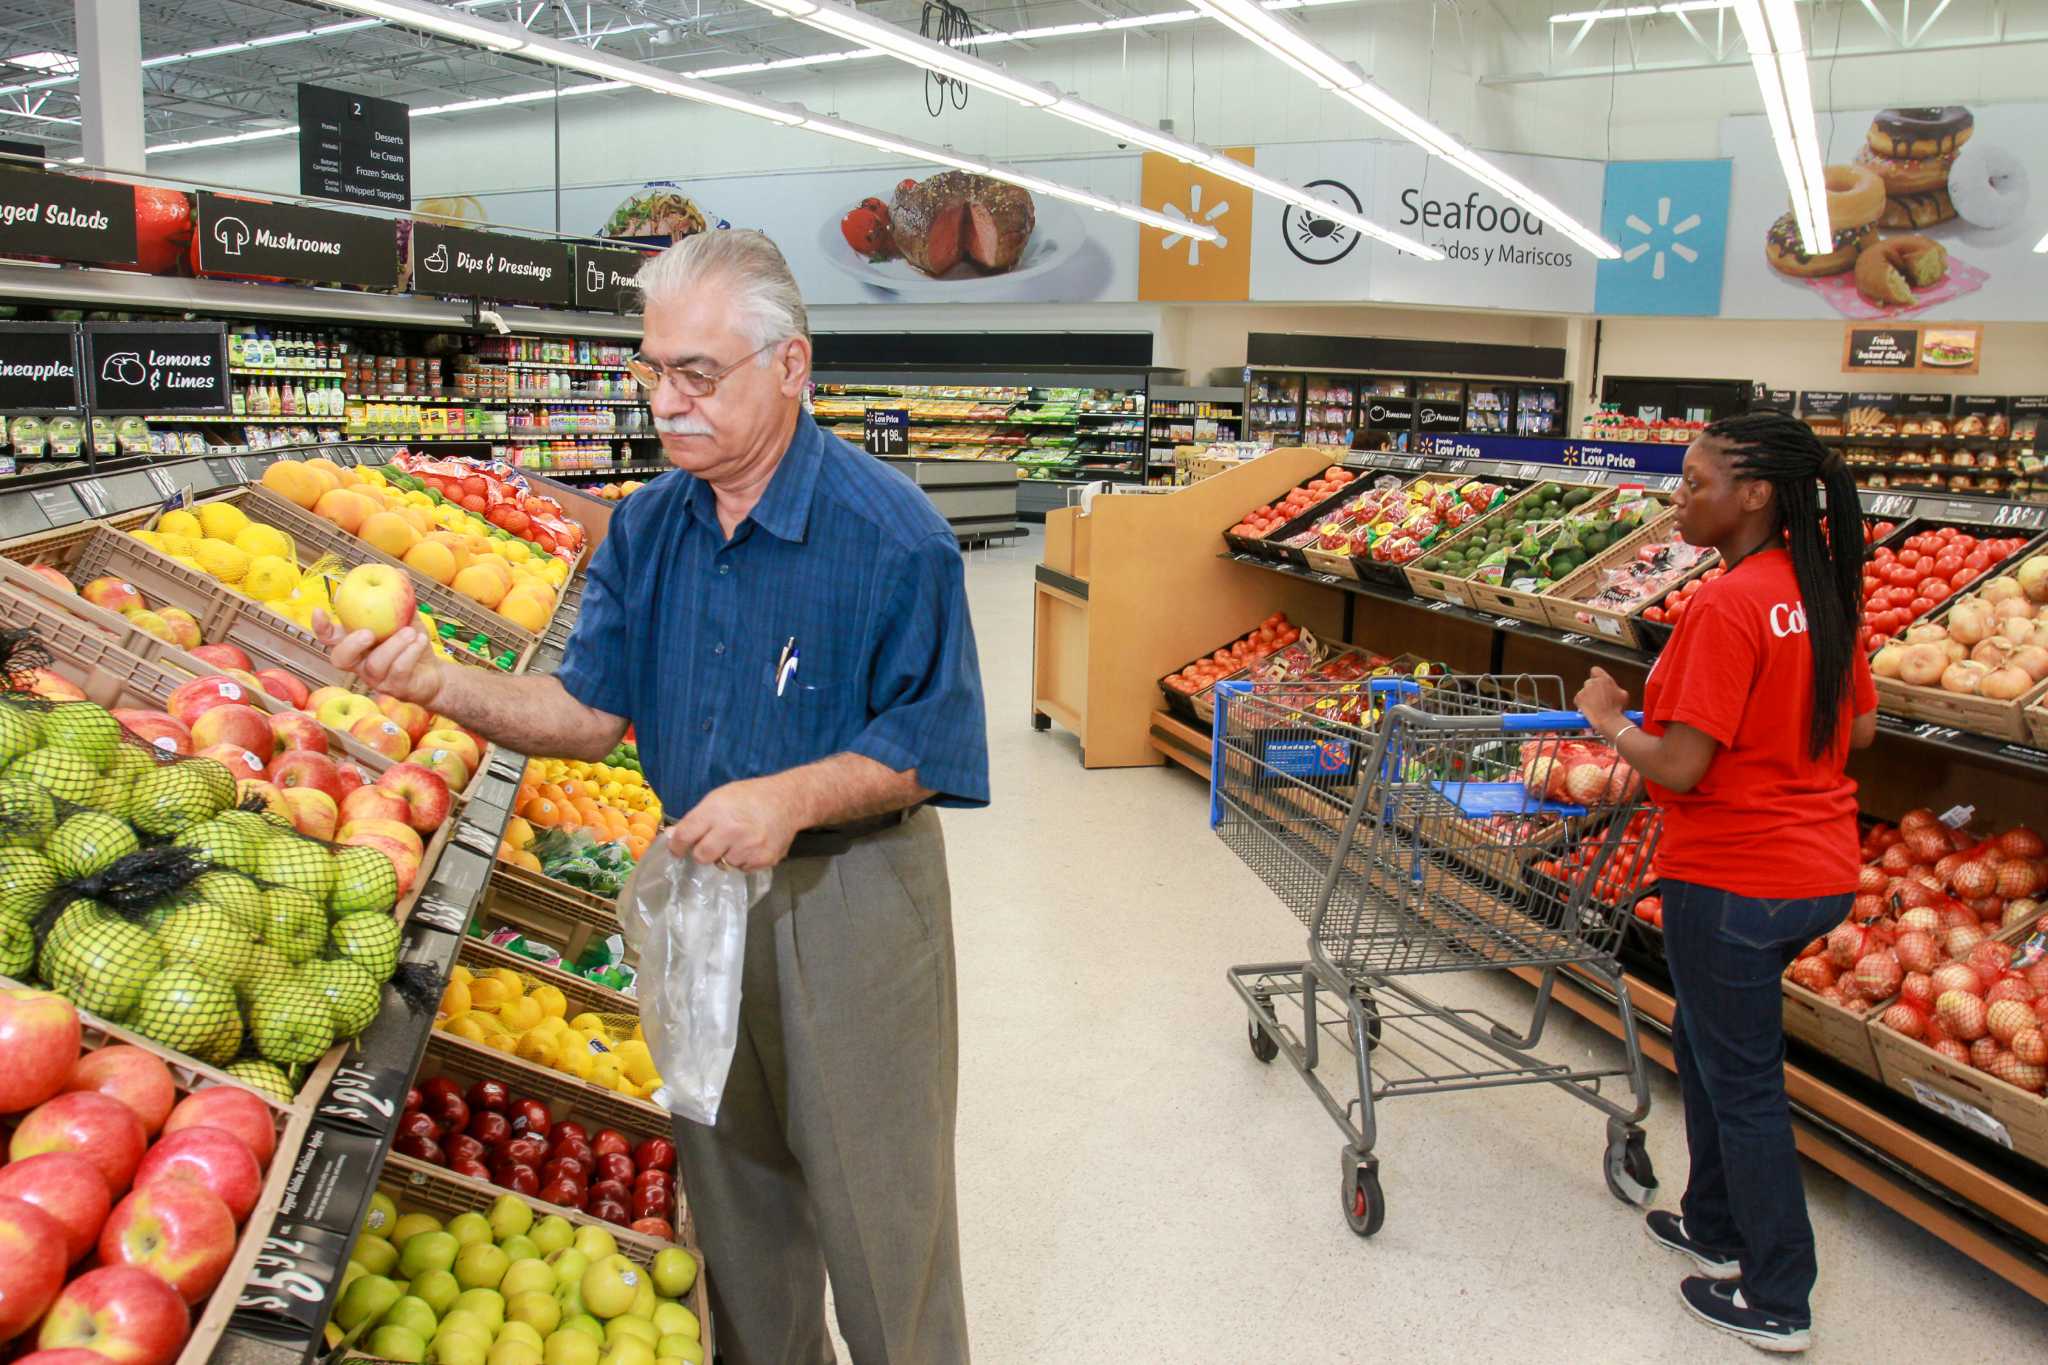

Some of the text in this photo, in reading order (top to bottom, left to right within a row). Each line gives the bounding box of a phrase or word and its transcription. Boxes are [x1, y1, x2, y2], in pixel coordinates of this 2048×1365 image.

[353, 102, 362, 116] 2
[375, 131, 404, 145] Desserts
[370, 149, 404, 163] Ice Cream
[356, 166, 404, 182] Frozen Snacks
[344, 184, 375, 197] Whipped
[376, 188, 404, 202] Toppings
[45, 204, 109, 230] Salads
[255, 228, 341, 255] Mushrooms
[1499, 244, 1573, 268] Mariscos
[456, 251, 552, 282] Dips & Dressings
[149, 350, 212, 367] Lemons
[150, 370, 215, 391] & Limes
[1435, 443, 1480, 458] Low Price
[1581, 450, 1636, 468] Low Price
